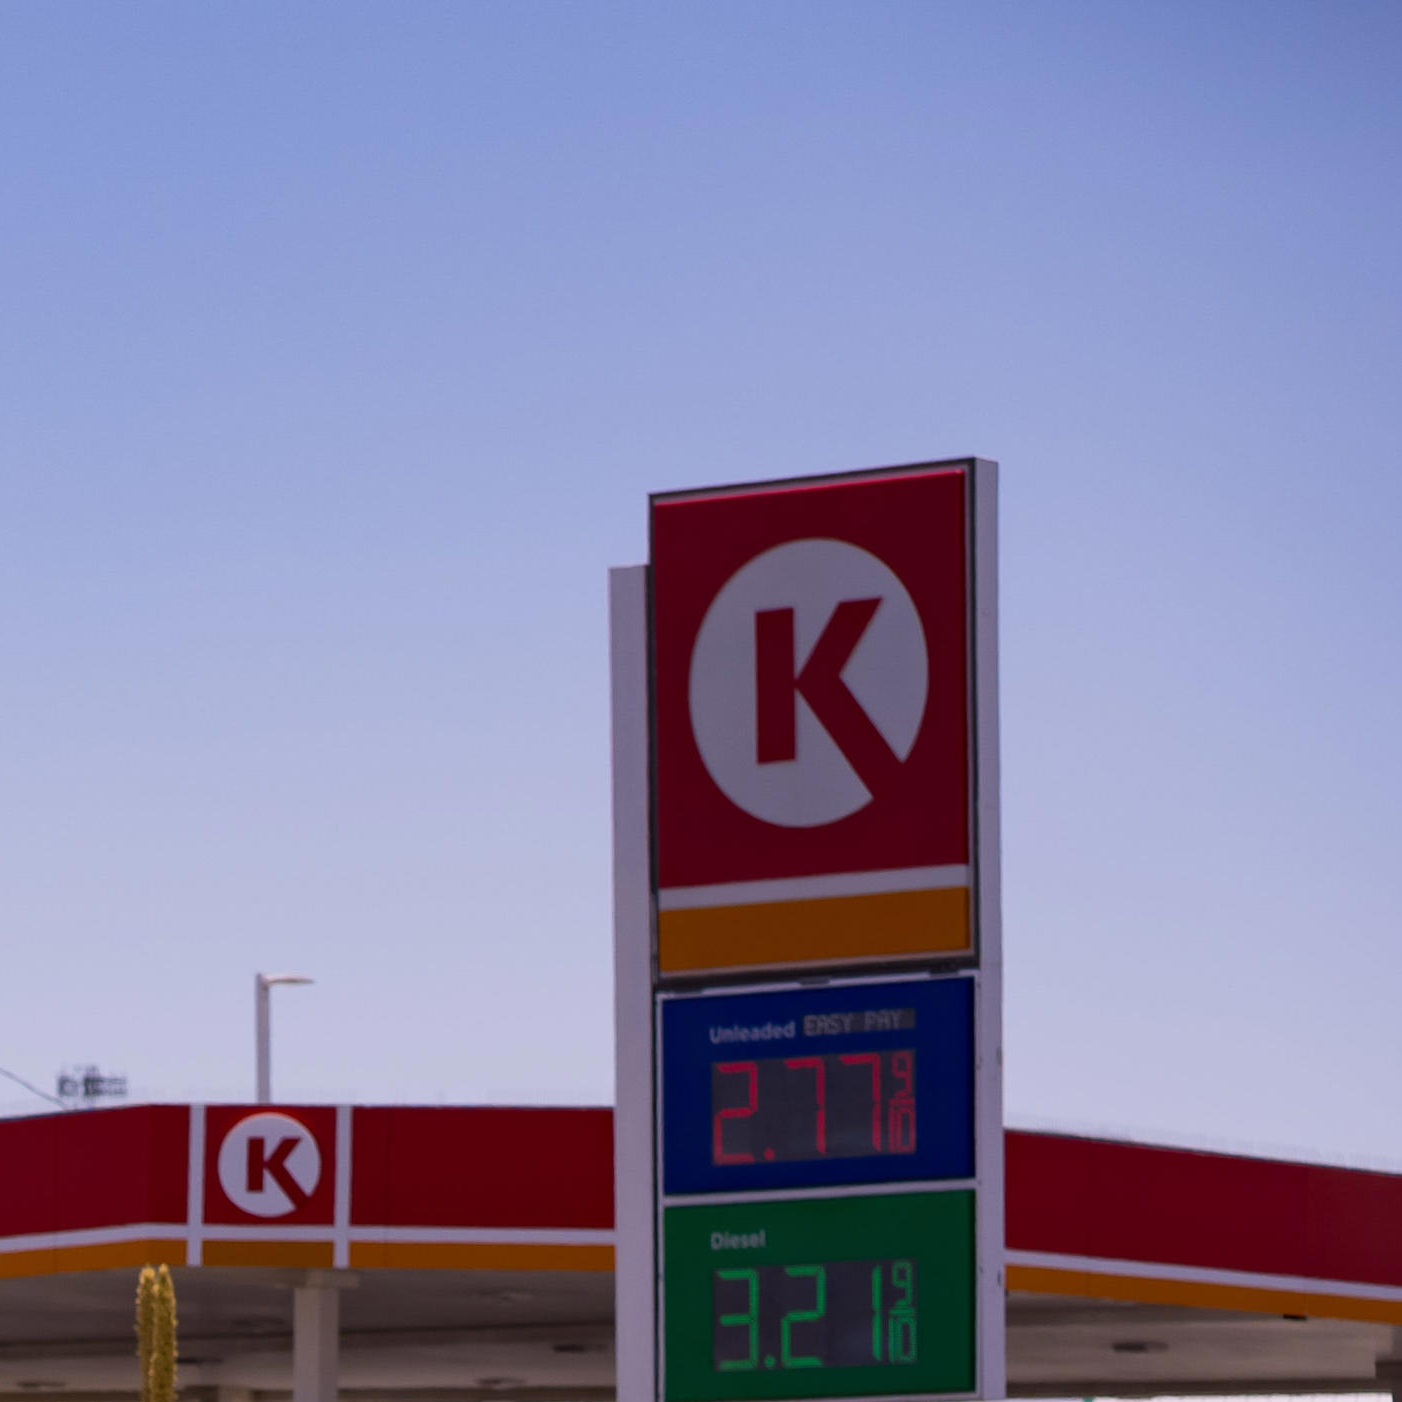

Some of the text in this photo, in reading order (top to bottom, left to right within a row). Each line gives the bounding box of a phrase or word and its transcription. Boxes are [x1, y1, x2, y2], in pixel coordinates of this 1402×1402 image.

[755, 596, 902, 800] K
[709, 1008, 902, 1043] Unleaded EASY PAY
[712, 1053, 882, 1165] 2.77
[246, 1136, 309, 1209] K
[711, 1230, 765, 1250] Diesel
[717, 1263, 882, 1372] 3.21
